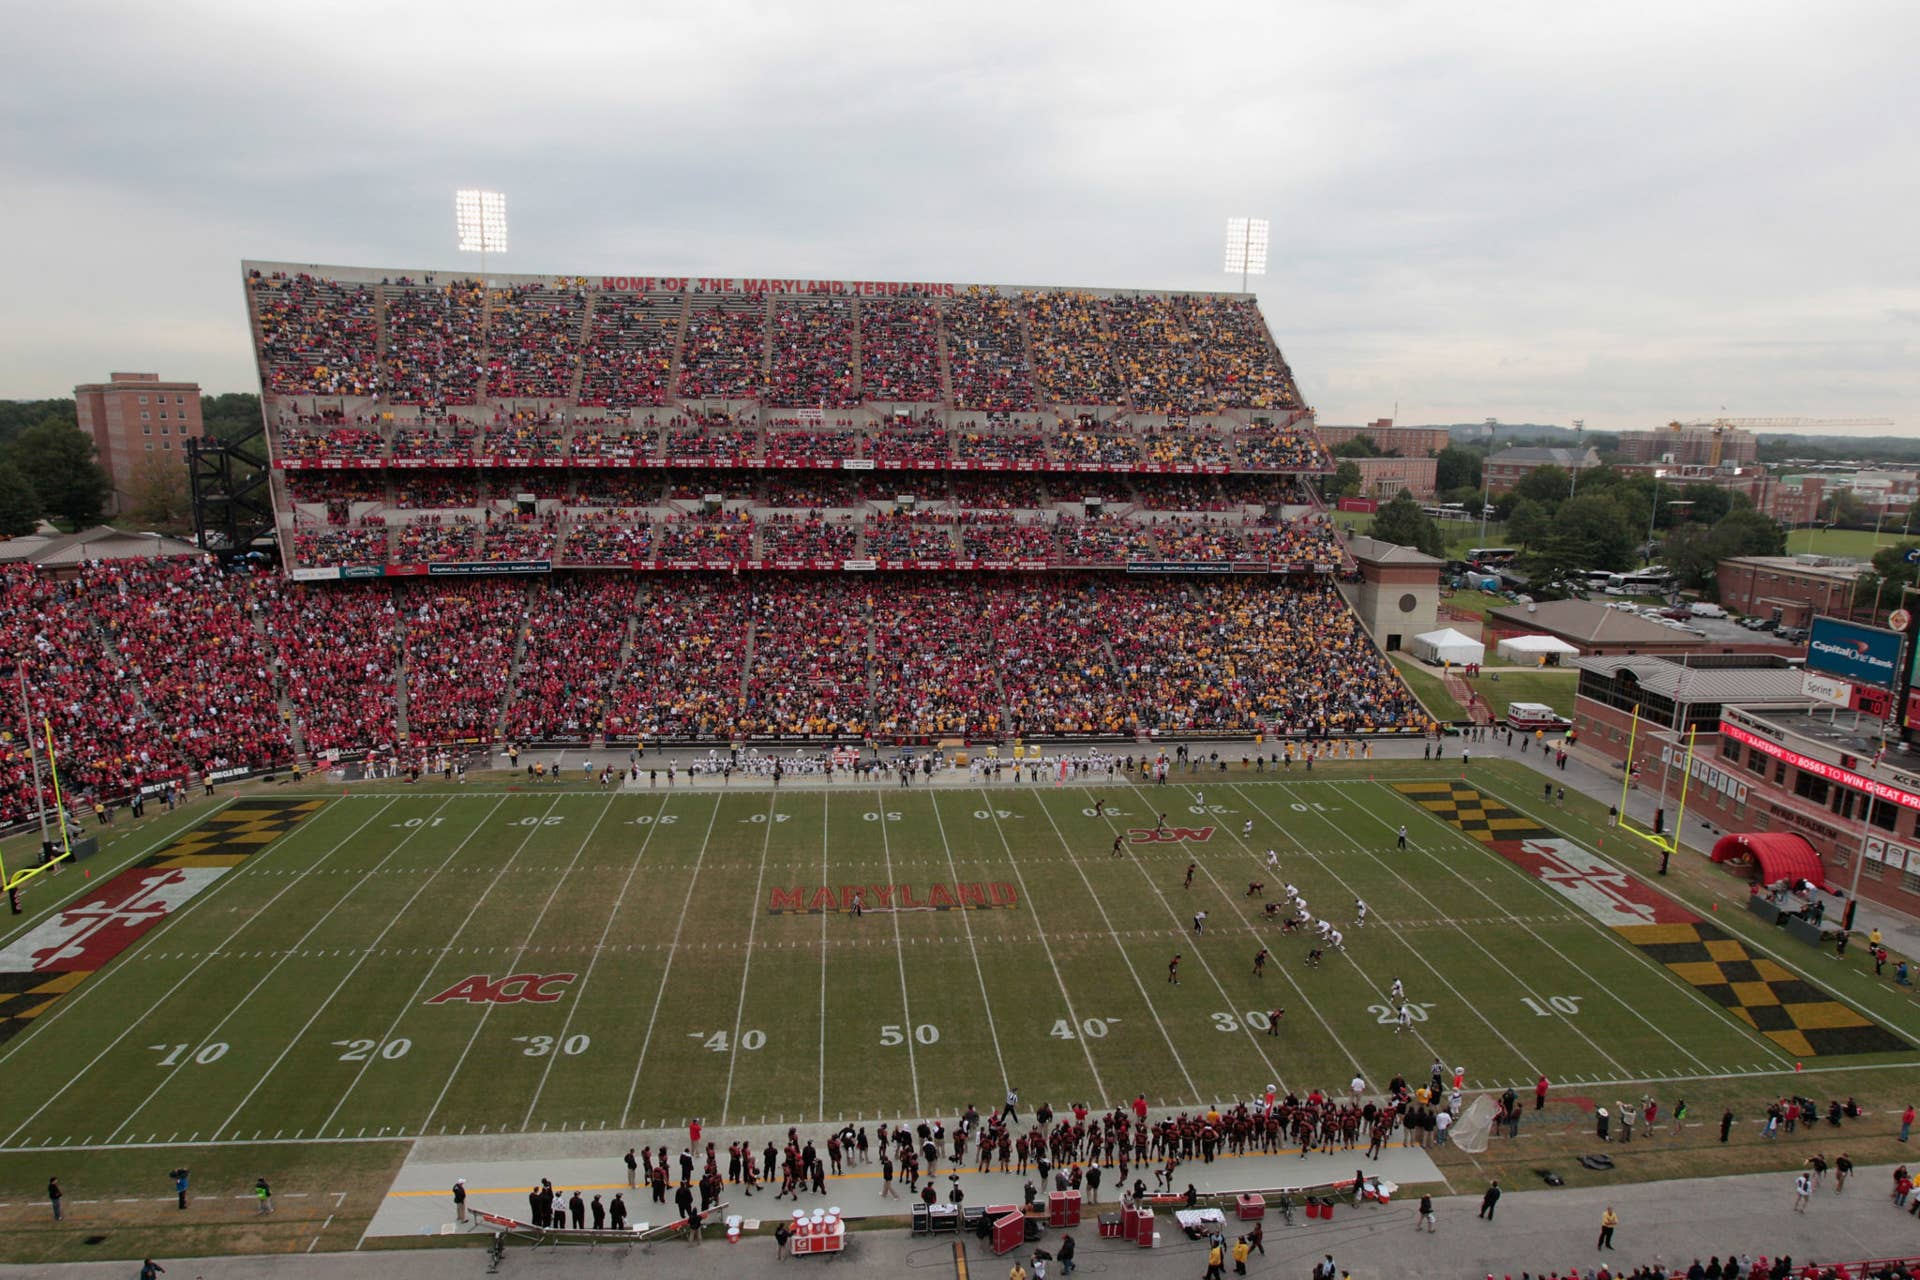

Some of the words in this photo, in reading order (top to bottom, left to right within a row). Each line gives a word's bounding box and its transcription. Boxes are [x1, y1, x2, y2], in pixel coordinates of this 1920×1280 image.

[602, 277, 656, 291] HOME
[665, 277, 689, 291] OF
[698, 278, 734, 292] THE
[743, 279, 844, 294] MARYLAND
[852, 281, 954, 296] TERRAPINS
[1868, 655, 1895, 669] Bank
[1807, 681, 1832, 697] Sprint
[1786, 752, 1797, 764] TO
[1829, 767, 1841, 780] TO
[1843, 773, 1864, 788] WIN
[1865, 781, 1900, 801] GREAT
[520, 815, 565, 826] 20
[636, 814, 679, 825] 30
[748, 813, 792, 824] 40
[863, 811, 903, 822] 50
[973, 809, 1014, 820] 40
[1127, 826, 1217, 845] ACC
[769, 883, 1019, 909] MARYLAND
[424, 972, 579, 1005] ACC
[1367, 1002, 1429, 1024] 20
[1520, 995, 1580, 1017] 10
[1049, 1018, 1110, 1040] 40
[1211, 1010, 1271, 1032] 30
[523, 1033, 592, 1057] 30
[703, 1029, 768, 1052] 40
[879, 1023, 941, 1047] 50
[155, 1041, 231, 1067] 10
[337, 1037, 414, 1062] 20
